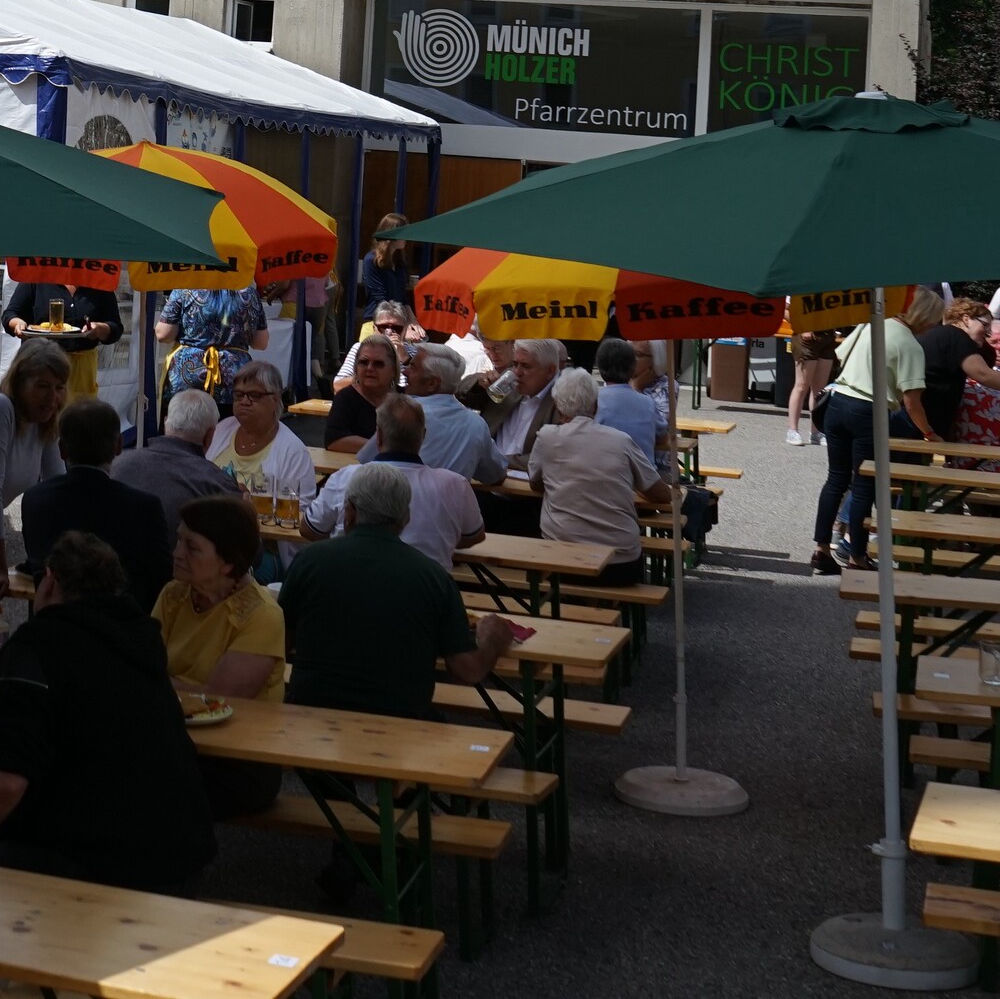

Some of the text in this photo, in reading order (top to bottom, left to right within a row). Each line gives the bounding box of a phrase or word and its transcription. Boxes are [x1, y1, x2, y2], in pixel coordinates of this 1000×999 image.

[486, 19, 591, 57] MÜNICH
[484, 53, 577, 85] HOLZER
[719, 43, 860, 78] CHRIST
[514, 97, 688, 131] Pfarrzentrum
[261, 249, 329, 273] Kaffee
[501, 300, 598, 322] Meinl
[627, 296, 776, 323] Kaffee
[801, 290, 875, 315] Mein
